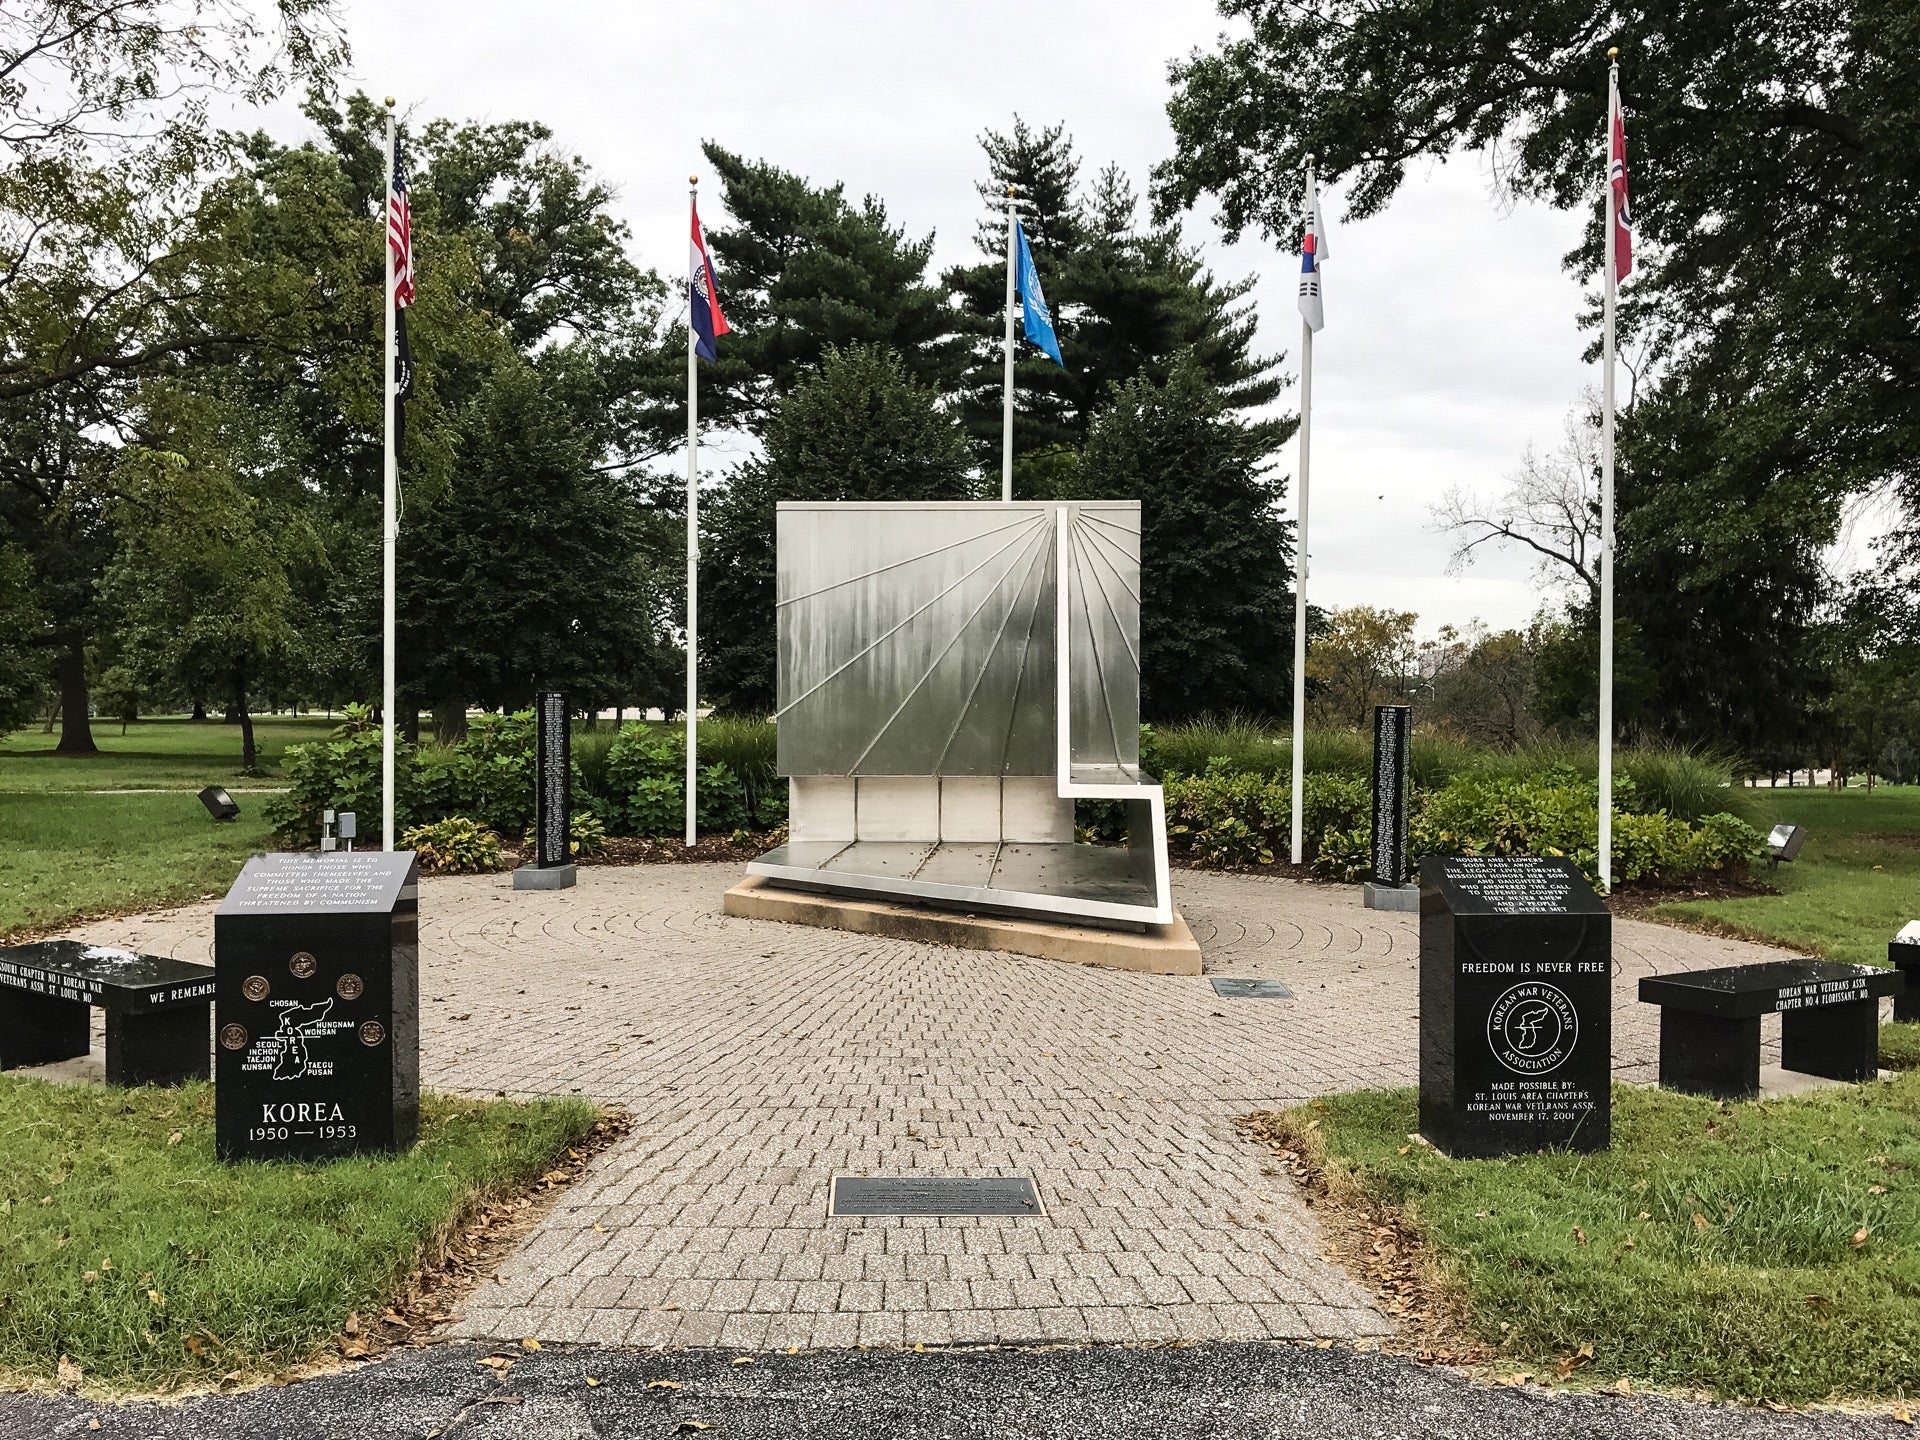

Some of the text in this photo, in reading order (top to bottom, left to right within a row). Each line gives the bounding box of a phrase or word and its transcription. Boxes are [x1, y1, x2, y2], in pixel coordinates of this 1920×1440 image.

[1462, 962, 1605, 973] FREEDOM IS NEVER FREE
[0, 973, 27, 989] VETERANS
[48, 984, 58, 996] ST.
[20, 966, 45, 981] CHAPTER
[63, 976, 86, 990] KOREAN
[89, 981, 103, 994] WAR
[1779, 985, 1801, 999] KOREAN
[1804, 984, 1817, 995] WAR
[1820, 980, 1849, 993] VETERANS
[149, 992, 165, 1004] WE
[1493, 987, 1573, 1030] KOREAN WAR VETERANS
[1776, 998, 1802, 1011] CHAPTER
[316, 1021, 355, 1029] HUNGNAM
[1502, 1047, 1563, 1069] ASSOCIATION
[241, 1063, 273, 1071] KUNSAN
[308, 1061, 334, 1069] TAEGU
[1491, 1081, 1576, 1090] MADE POSSIBLE BY:
[1492, 1092, 1517, 1100] LOUIS
[1521, 1092, 1543, 1100] AREA
[1546, 1091, 1589, 1100] CHAPTERS
[1467, 1101, 1596, 1111] KOREAN WAR VETERANS ASSN.
[262, 1102, 345, 1123] KOREA
[1489, 1113, 1534, 1121] NOVEMBER
[1553, 1112, 1575, 1120] 2001
[249, 1127, 289, 1141] 1950
[319, 1125, 356, 1139] 1953
